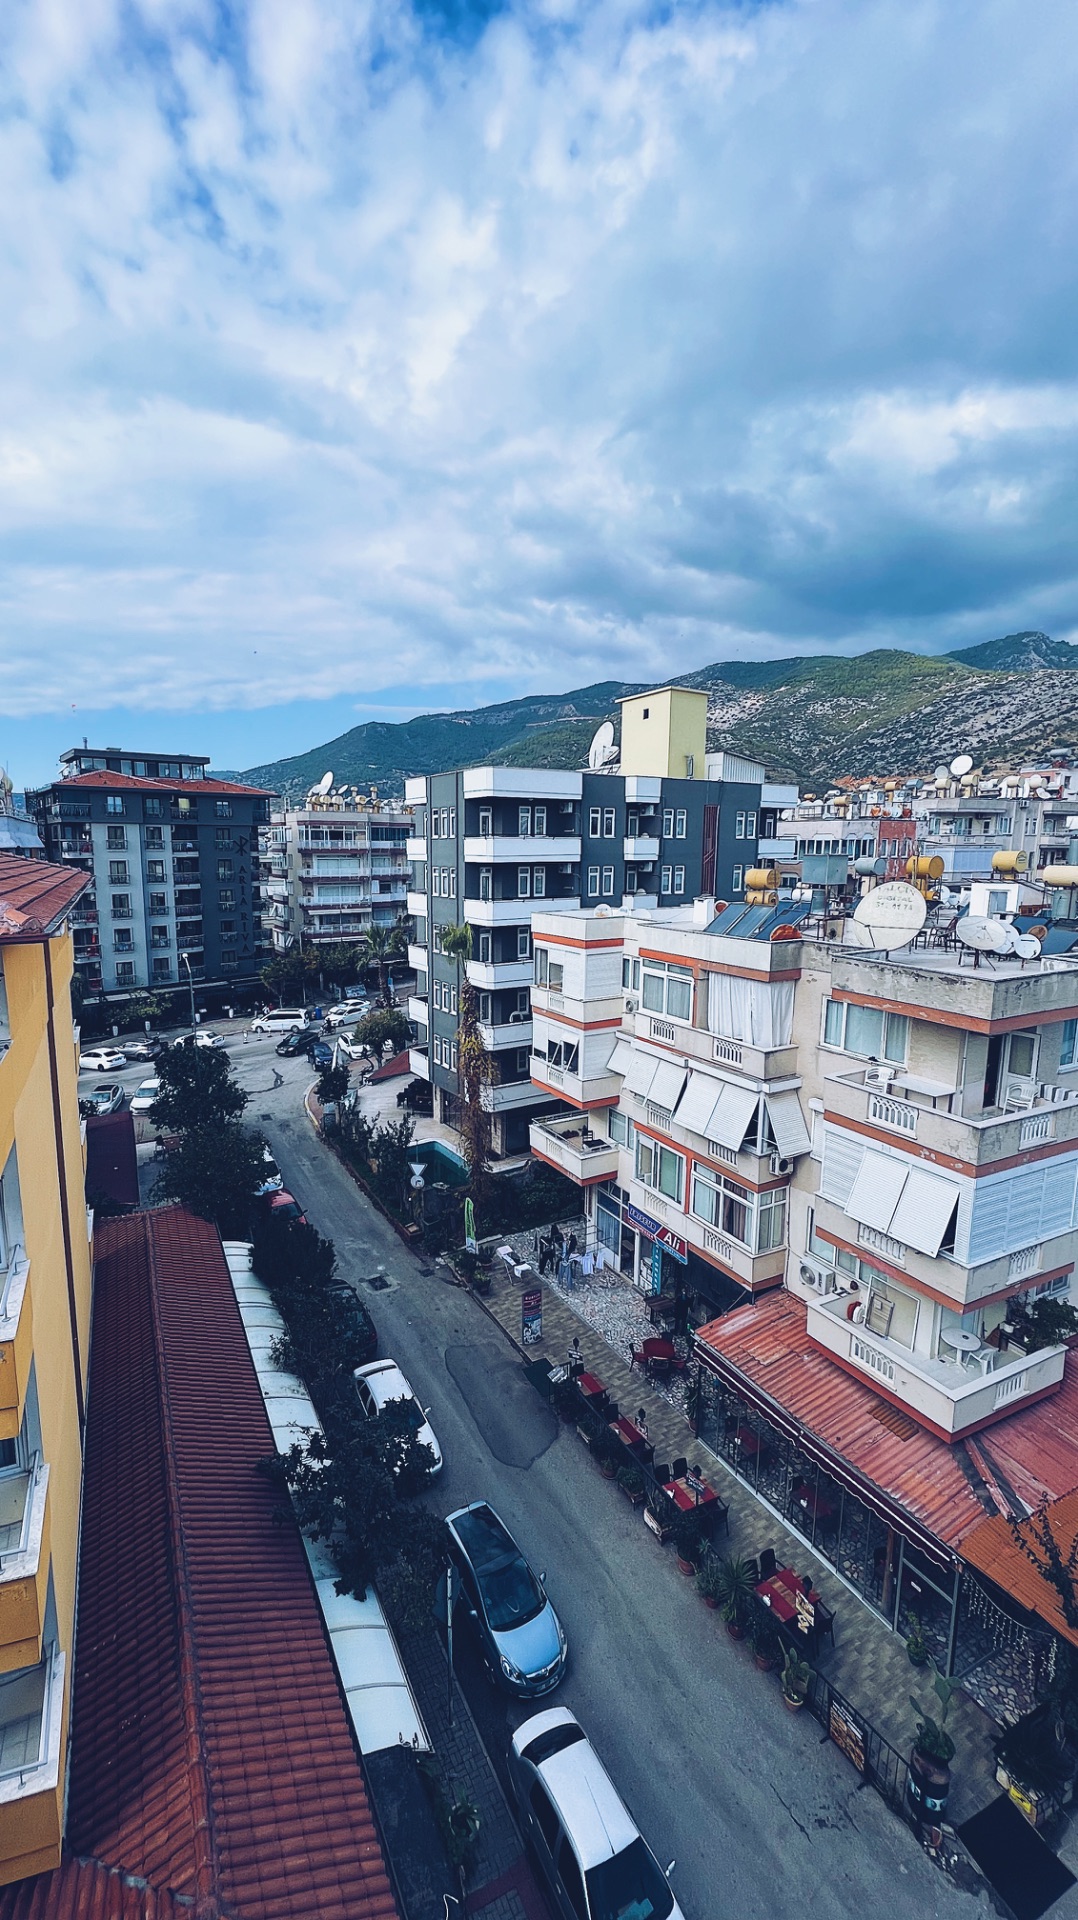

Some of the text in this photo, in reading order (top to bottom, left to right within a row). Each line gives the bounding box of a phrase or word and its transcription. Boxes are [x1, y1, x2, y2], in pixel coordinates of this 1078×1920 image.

[238, 865, 250, 952] ARIA RIVA
[663, 1232, 681, 1253] Ali
